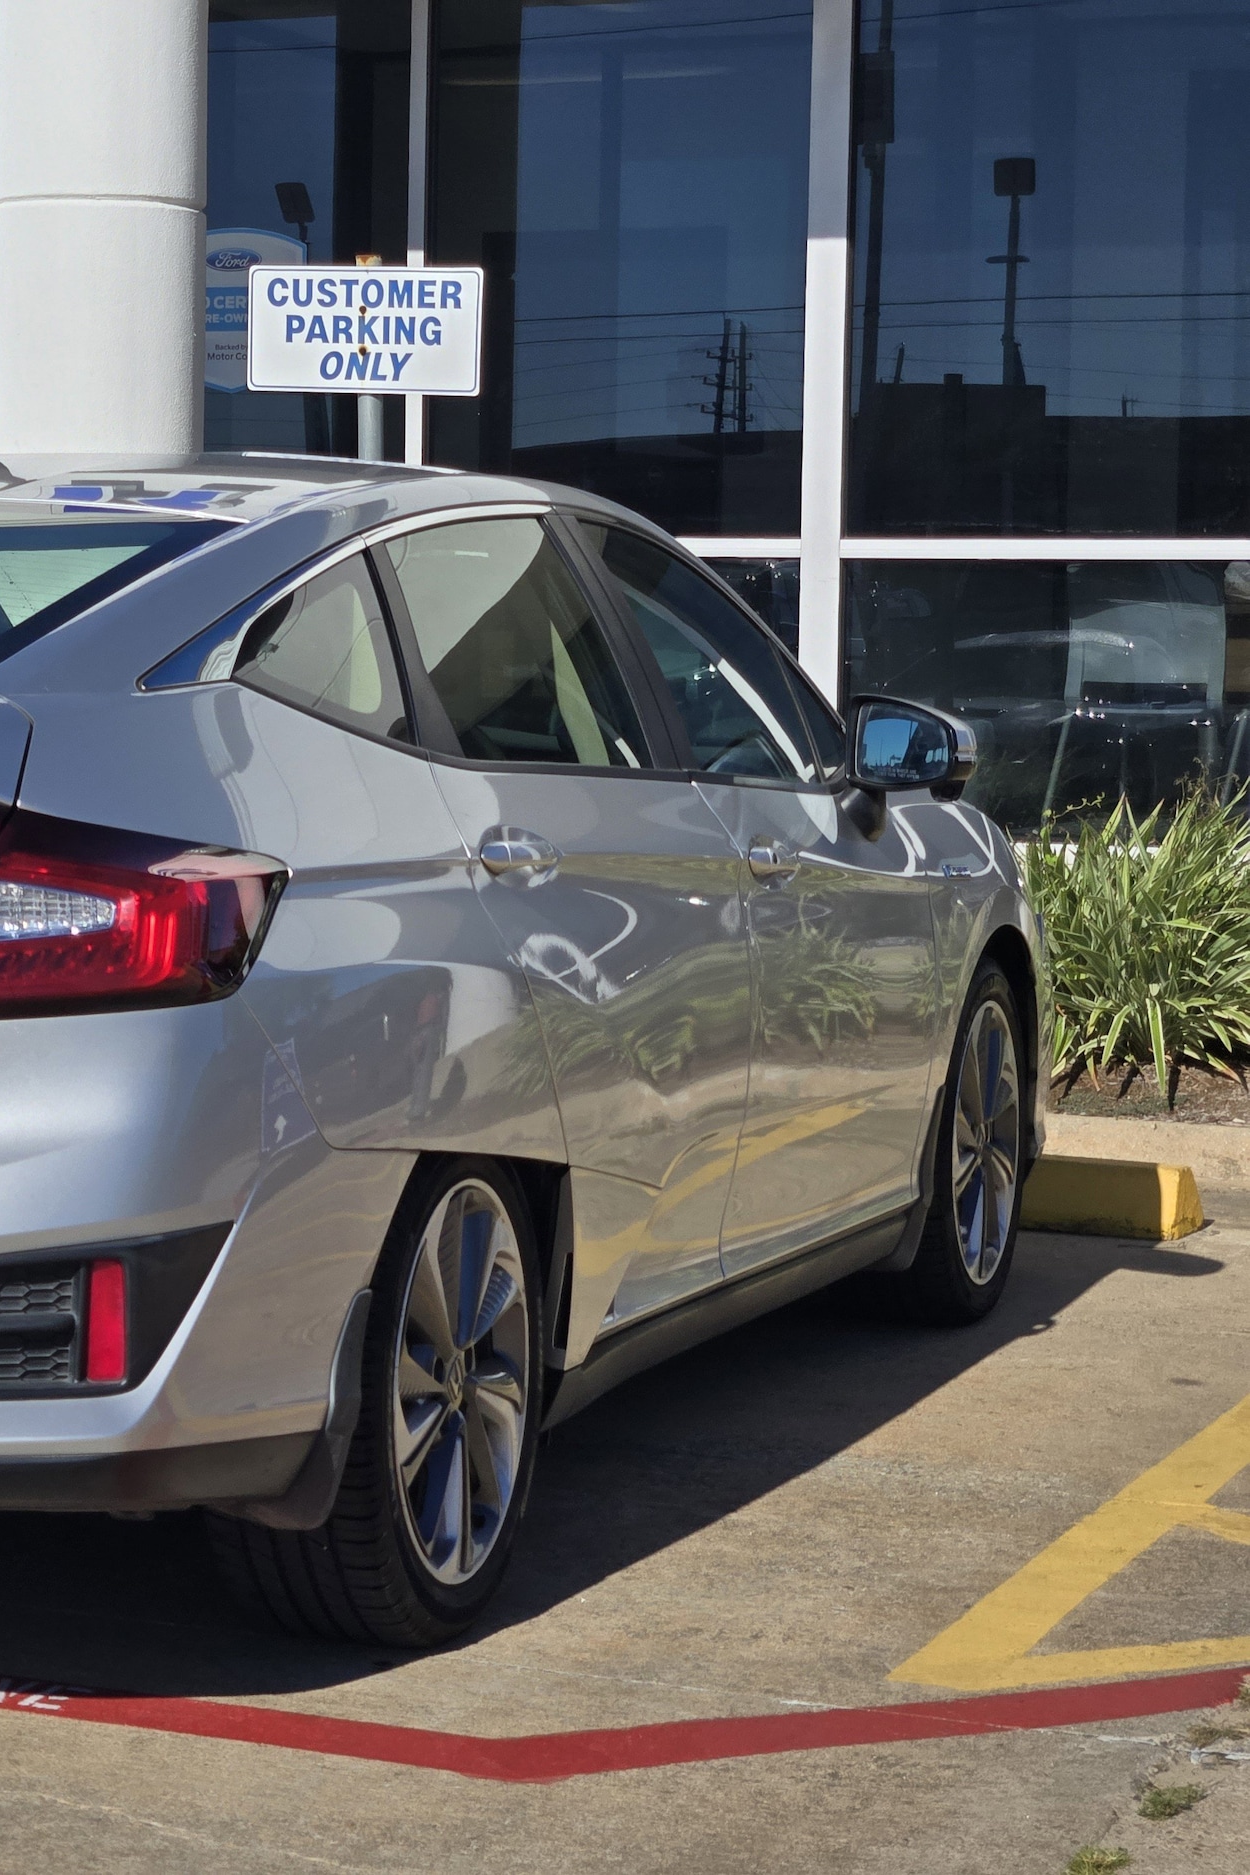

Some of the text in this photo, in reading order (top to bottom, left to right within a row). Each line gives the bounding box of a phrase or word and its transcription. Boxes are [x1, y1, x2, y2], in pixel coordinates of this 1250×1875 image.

[215, 252, 250, 267] Ford
[267, 277, 462, 309] CUSTOMER
[285, 314, 442, 346] PARKING
[207, 353, 233, 361] Motor
[319, 350, 413, 382] ONLY
